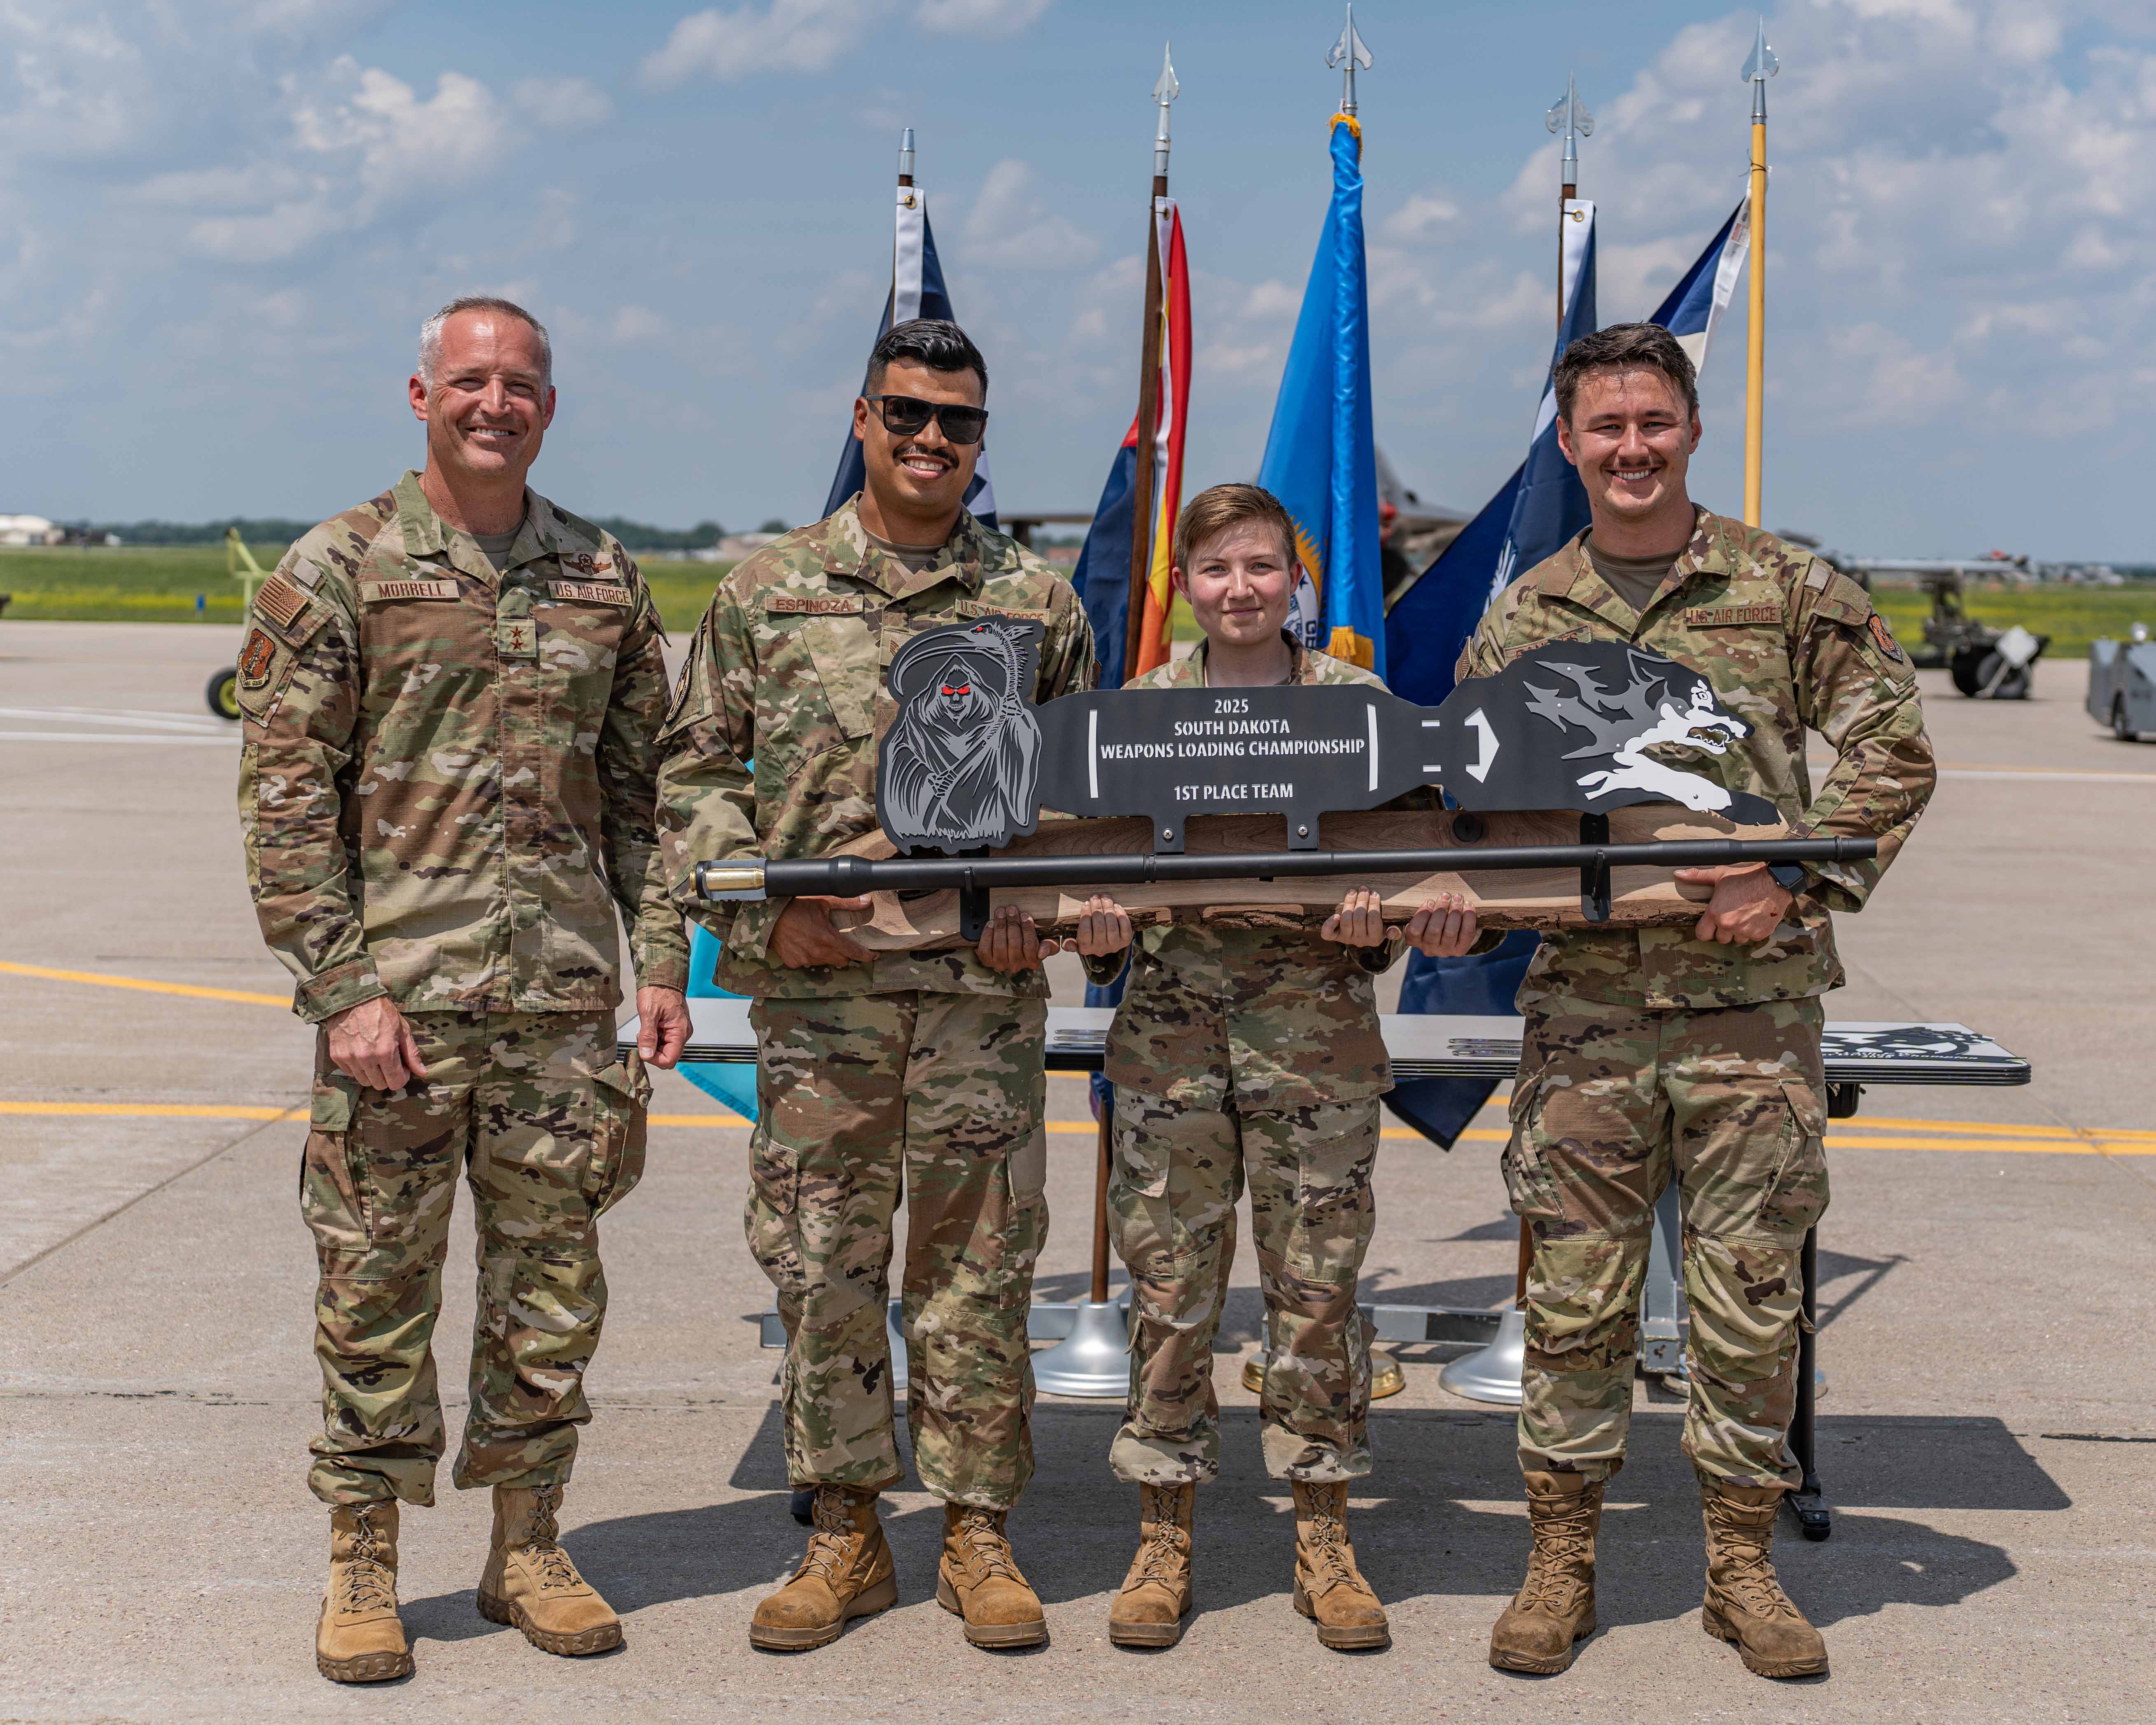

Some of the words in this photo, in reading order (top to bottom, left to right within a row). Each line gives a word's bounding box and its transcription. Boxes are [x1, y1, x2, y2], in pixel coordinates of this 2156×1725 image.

[377, 582, 446, 598] MORRELL
[555, 583, 573, 597] U.S.
[577, 585, 594, 599] AIR
[596, 587, 630, 604] FORCE
[776, 598, 851, 612] ESPINOZA
[1713, 608, 1733, 623] AIR
[1736, 606, 1776, 623] FORCE
[1214, 698, 1249, 714] 2025
[1174, 721, 1224, 735] SOUTH
[1229, 719, 1290, 735] DAKOTA
[1100, 742, 1174, 759] WEAPONS
[1178, 741, 1245, 757] LOADING
[1249, 739, 1365, 756] CHAMPIONSHIP
[1174, 785, 1199, 801] 1ST
[1203, 784, 1249, 800] PLACE
[1251, 783, 1293, 798] TEAM
